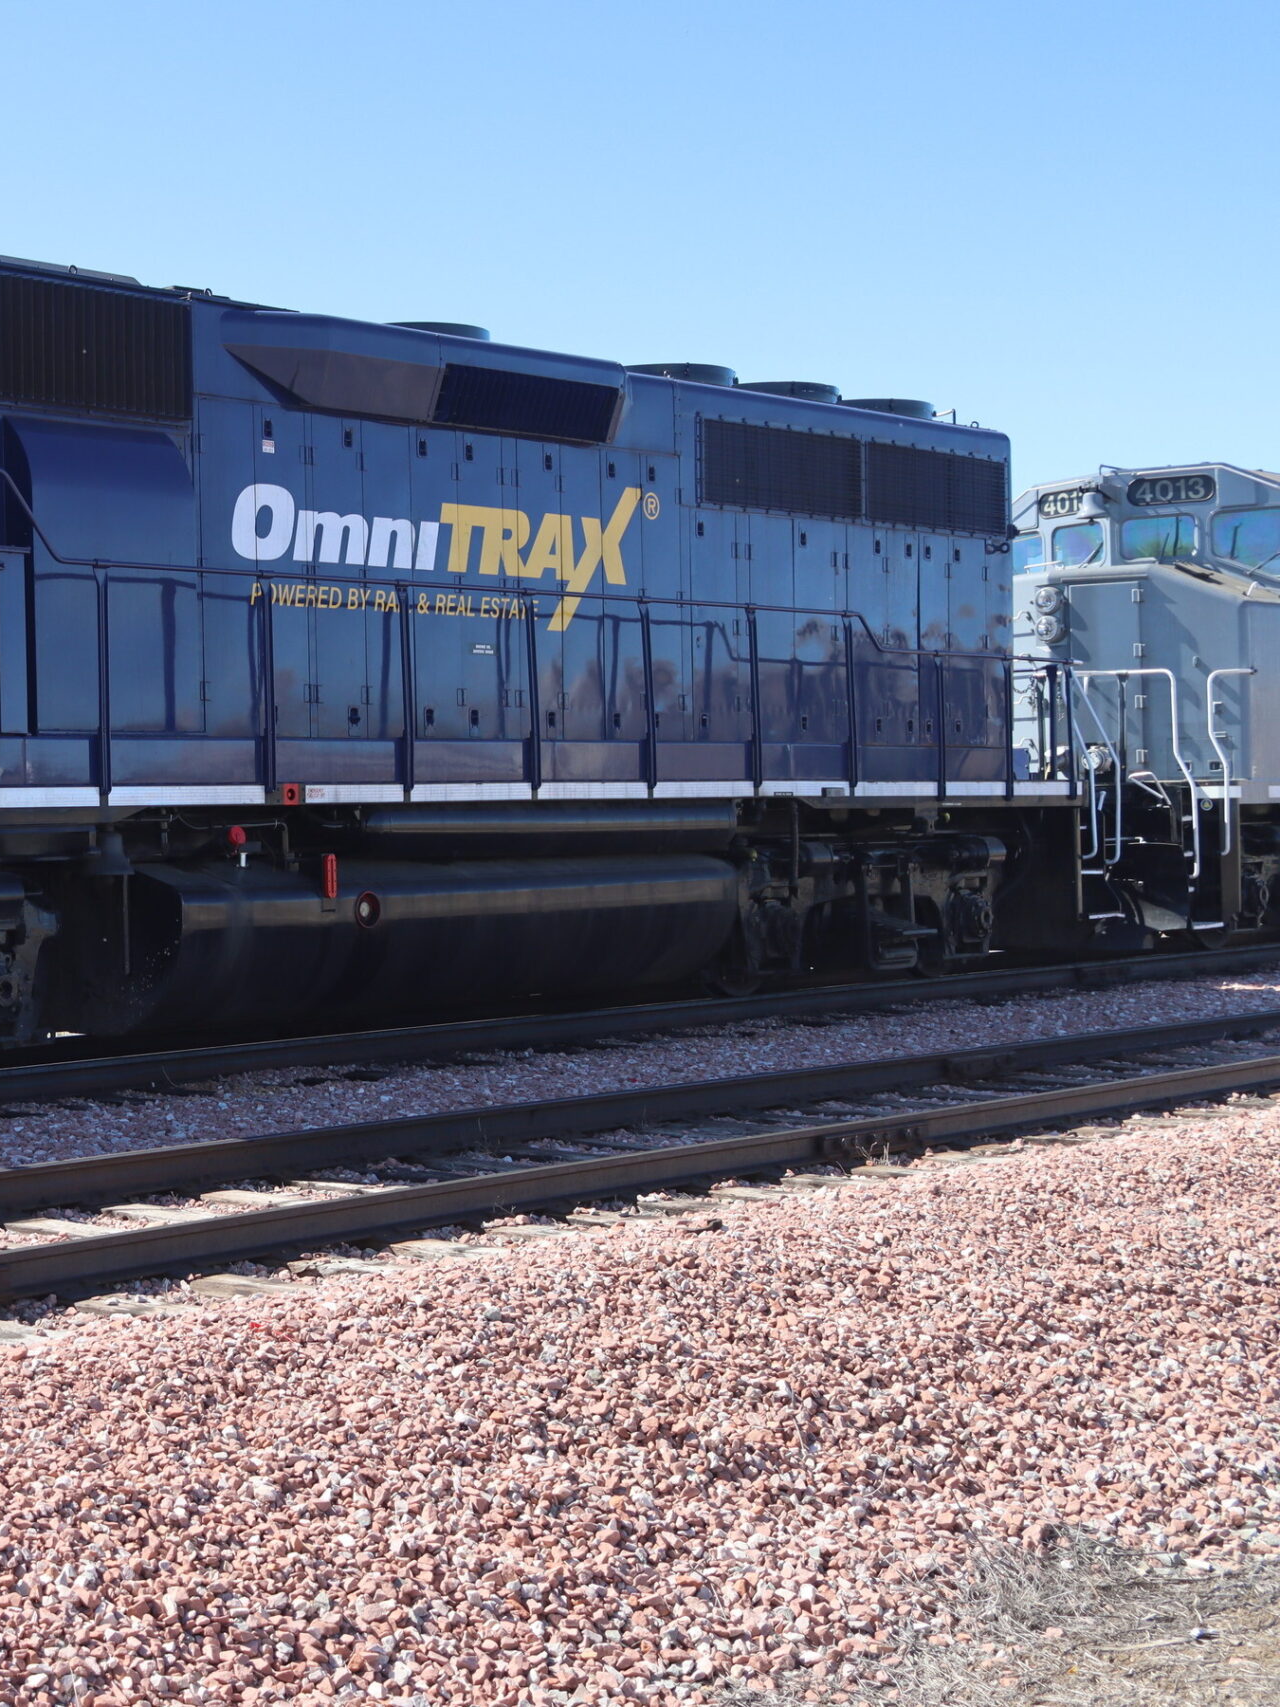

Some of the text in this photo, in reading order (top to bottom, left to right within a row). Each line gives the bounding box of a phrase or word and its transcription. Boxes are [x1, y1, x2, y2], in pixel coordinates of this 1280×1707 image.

[1135, 477, 1205, 502] 4013
[347, 588, 371, 611] BY
[417, 593, 430, 615] &
[435, 594, 475, 617] REAL
